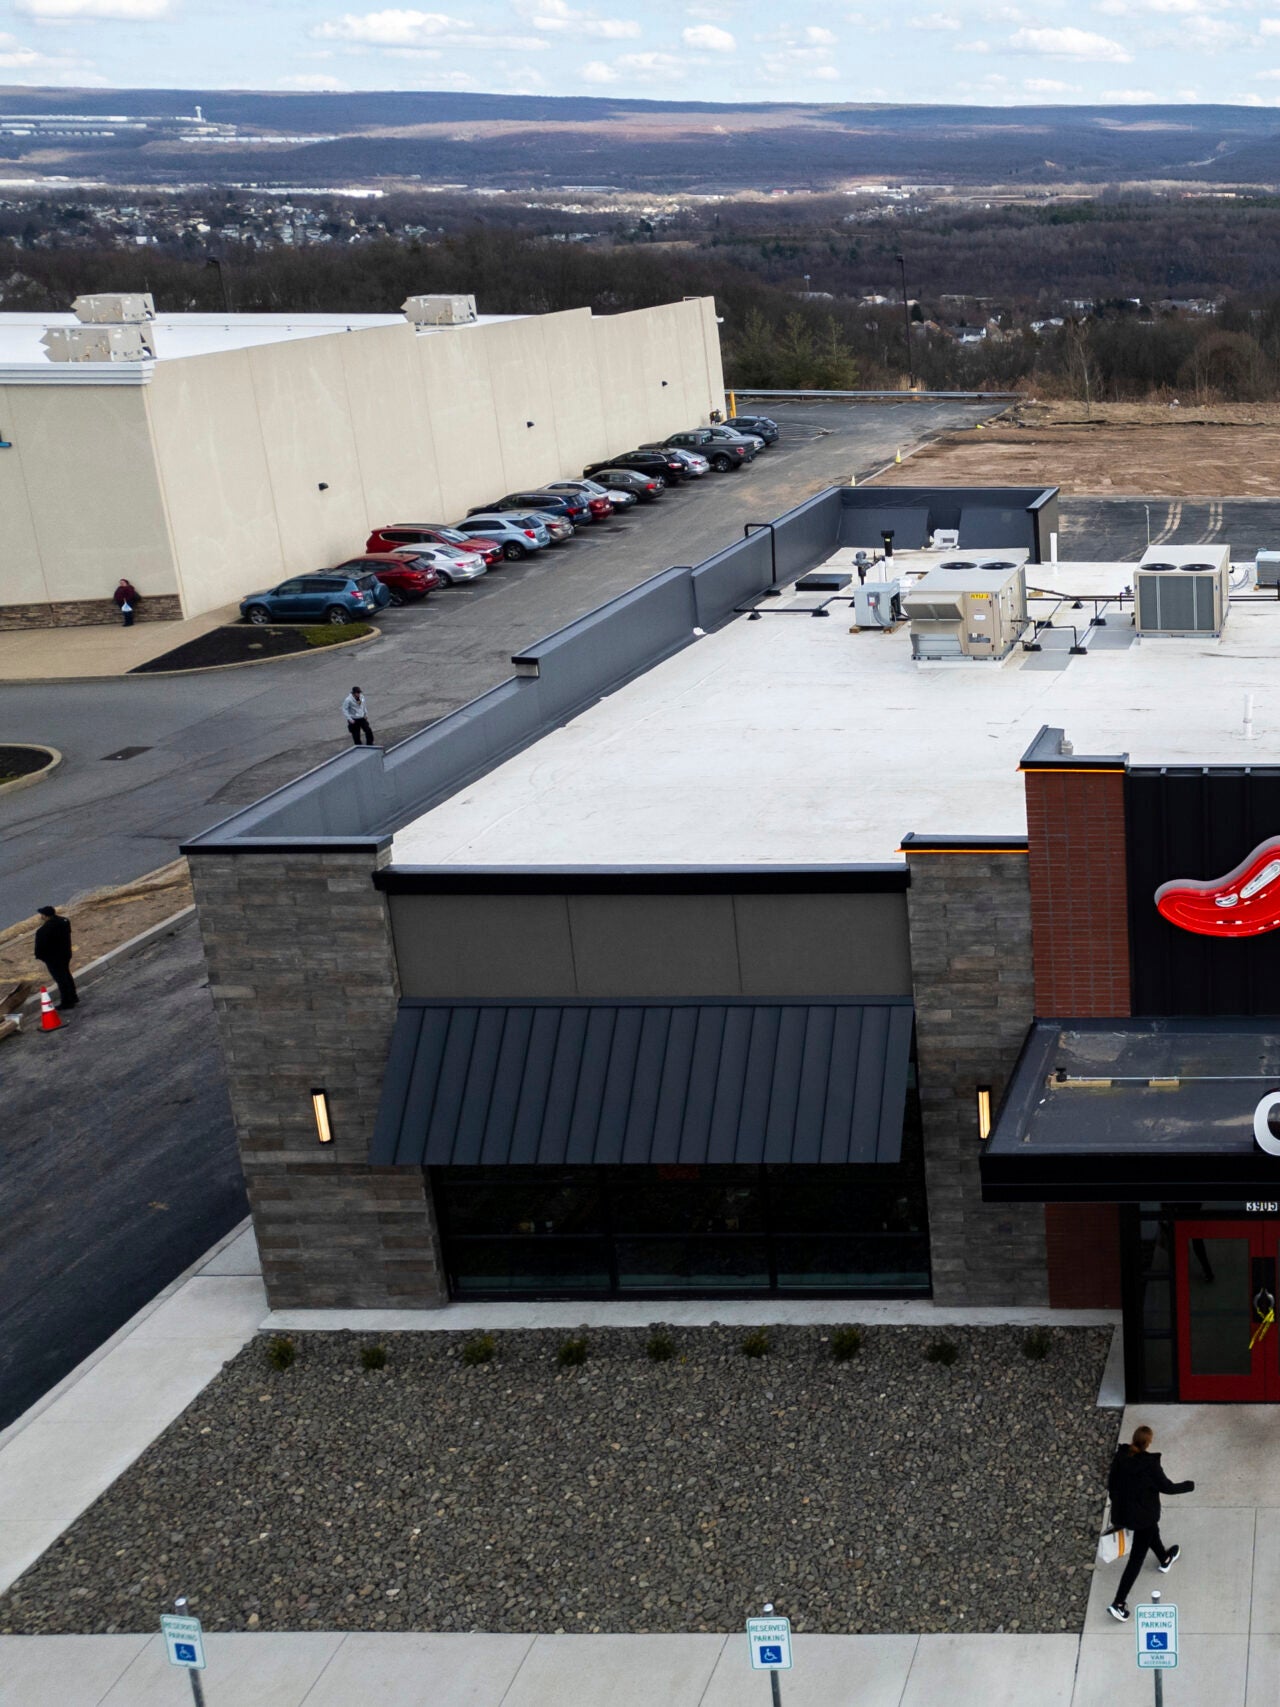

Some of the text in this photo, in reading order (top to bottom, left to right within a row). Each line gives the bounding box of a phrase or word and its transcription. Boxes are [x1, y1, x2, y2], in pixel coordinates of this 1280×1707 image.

[1247, 1201, 1278, 1211] 3905
[1138, 1611, 1175, 1619] RESERVED
[163, 1621, 200, 1631] RESERVED
[750, 1624, 787, 1632] RESERVED
[1141, 1621, 1173, 1629] PARKING
[168, 1631, 197, 1641] PARKING
[753, 1634, 785, 1642] PARKING
